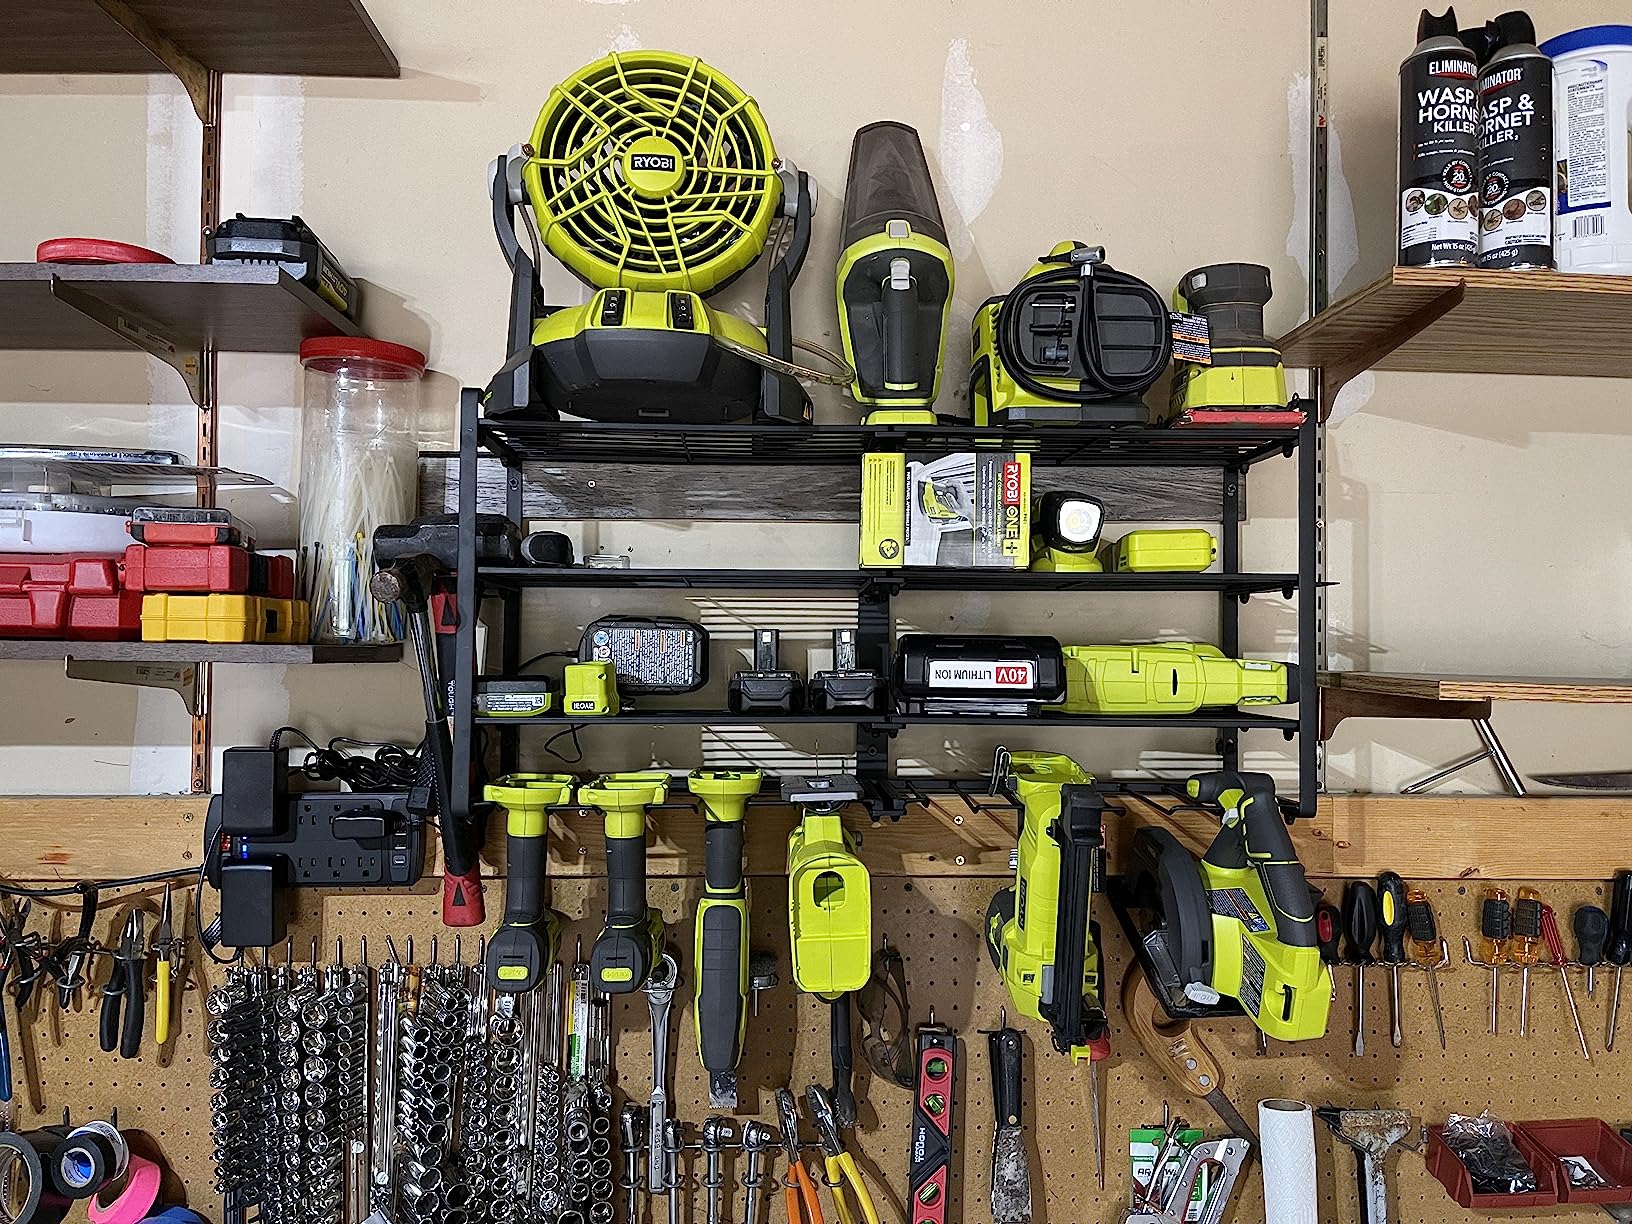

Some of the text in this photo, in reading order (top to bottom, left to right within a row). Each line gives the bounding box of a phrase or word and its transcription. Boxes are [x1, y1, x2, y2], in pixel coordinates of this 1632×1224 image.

[1480, 68, 1521, 91] MINATOR
[1418, 87, 1474, 107] WASP
[1480, 94, 1535, 119] ASP &
[1418, 104, 1479, 124] HORNE
[1479, 110, 1535, 138] ORNET
[1433, 121, 1476, 137] KILLER
[1482, 129, 1514, 149] ILLER
[633, 156, 673, 169] RYOBI
[1453, 172, 1464, 181] 20
[1486, 184, 1499, 194] 20
[1006, 464, 1020, 502] RYOBI
[935, 667, 1027, 683] 40V LITHIUM ION
[573, 702, 594, 710] RYOBI
[918, 1127, 926, 1163] TOUGH
[1138, 1167, 1177, 1177] ARW
